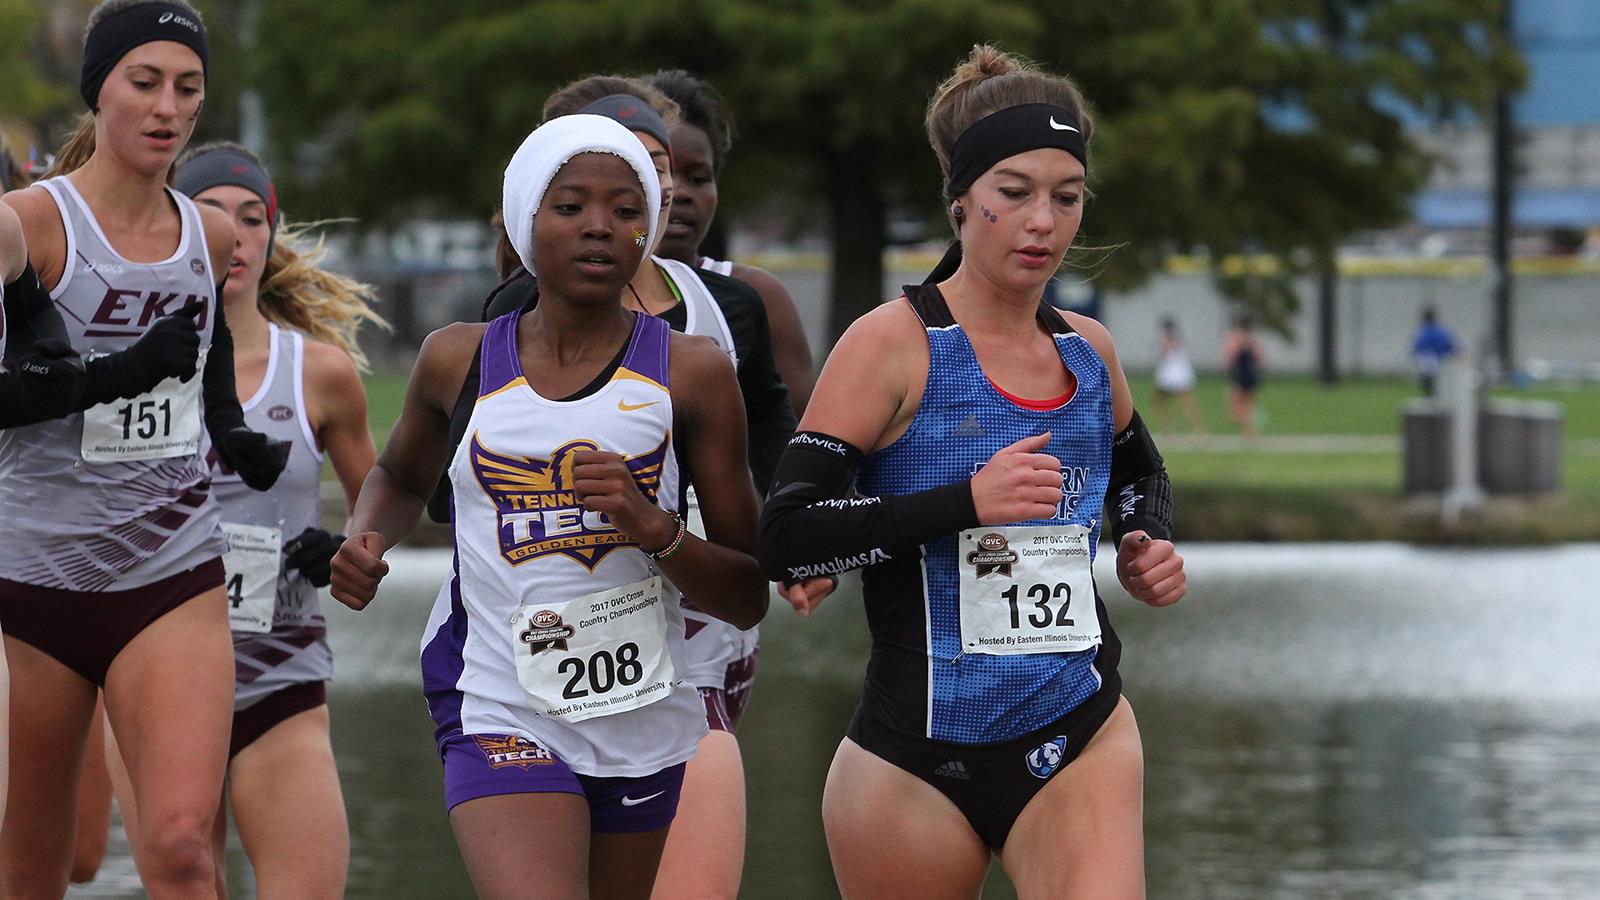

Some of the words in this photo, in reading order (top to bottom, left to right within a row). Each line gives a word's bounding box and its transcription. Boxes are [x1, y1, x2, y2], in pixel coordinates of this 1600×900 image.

[174, 15, 199, 33] asics
[118, 398, 171, 440] 151
[515, 537, 586, 558] GOLDEN
[595, 534, 638, 544] EAGL
[1033, 536, 1049, 544] 2017
[1049, 535, 1063, 544] OVC
[1064, 535, 1081, 543] Cross
[1022, 548, 1048, 557] Country
[1049, 547, 1088, 557] Championship
[788, 553, 869, 580] swiftwick
[579, 614, 608, 629] Country
[609, 596, 658, 620] Championships
[591, 601, 609, 613] 2017
[611, 596, 626, 608] OVC
[626, 589, 644, 602] Cross
[1001, 582, 1075, 629] 132
[979, 636, 1005, 645] Hosted
[1006, 636, 1016, 646] By
[1017, 635, 1043, 644] Eastern
[1044, 633, 1067, 642] Illinois
[558, 642, 643, 700] 208
[547, 706, 572, 716] Hosted
[573, 703, 583, 712] By
[583, 699, 609, 709] Eastern
[610, 692, 634, 705] Illinois
[635, 681, 665, 698] University
[488, 748, 552, 763] TECH
